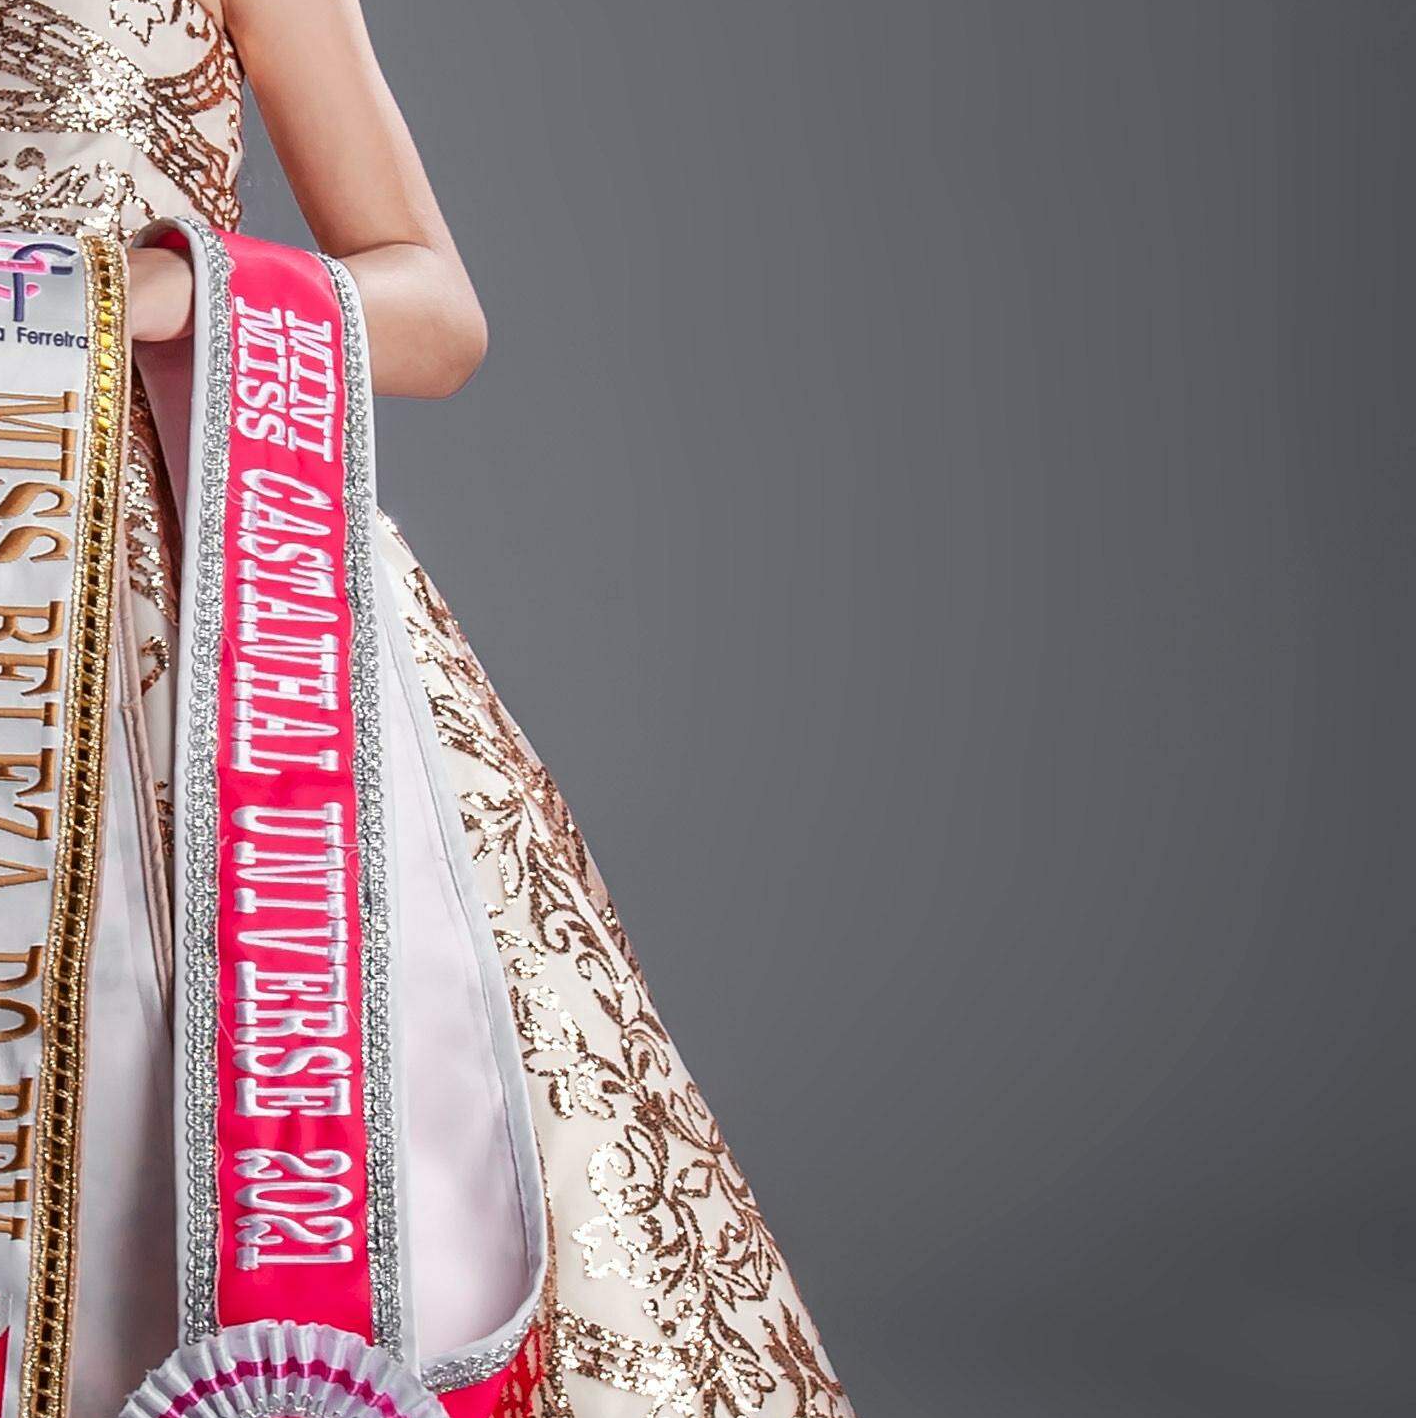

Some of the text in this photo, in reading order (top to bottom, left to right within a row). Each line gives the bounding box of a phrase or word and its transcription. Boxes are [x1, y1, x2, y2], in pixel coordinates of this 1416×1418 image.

[16, 327, 88, 349] Ferreira
[234, 296, 287, 446] MISS
[285, 310, 335, 462] MINI
[231, 468, 353, 1271] CASTANHAL UNIVERSE 2021
